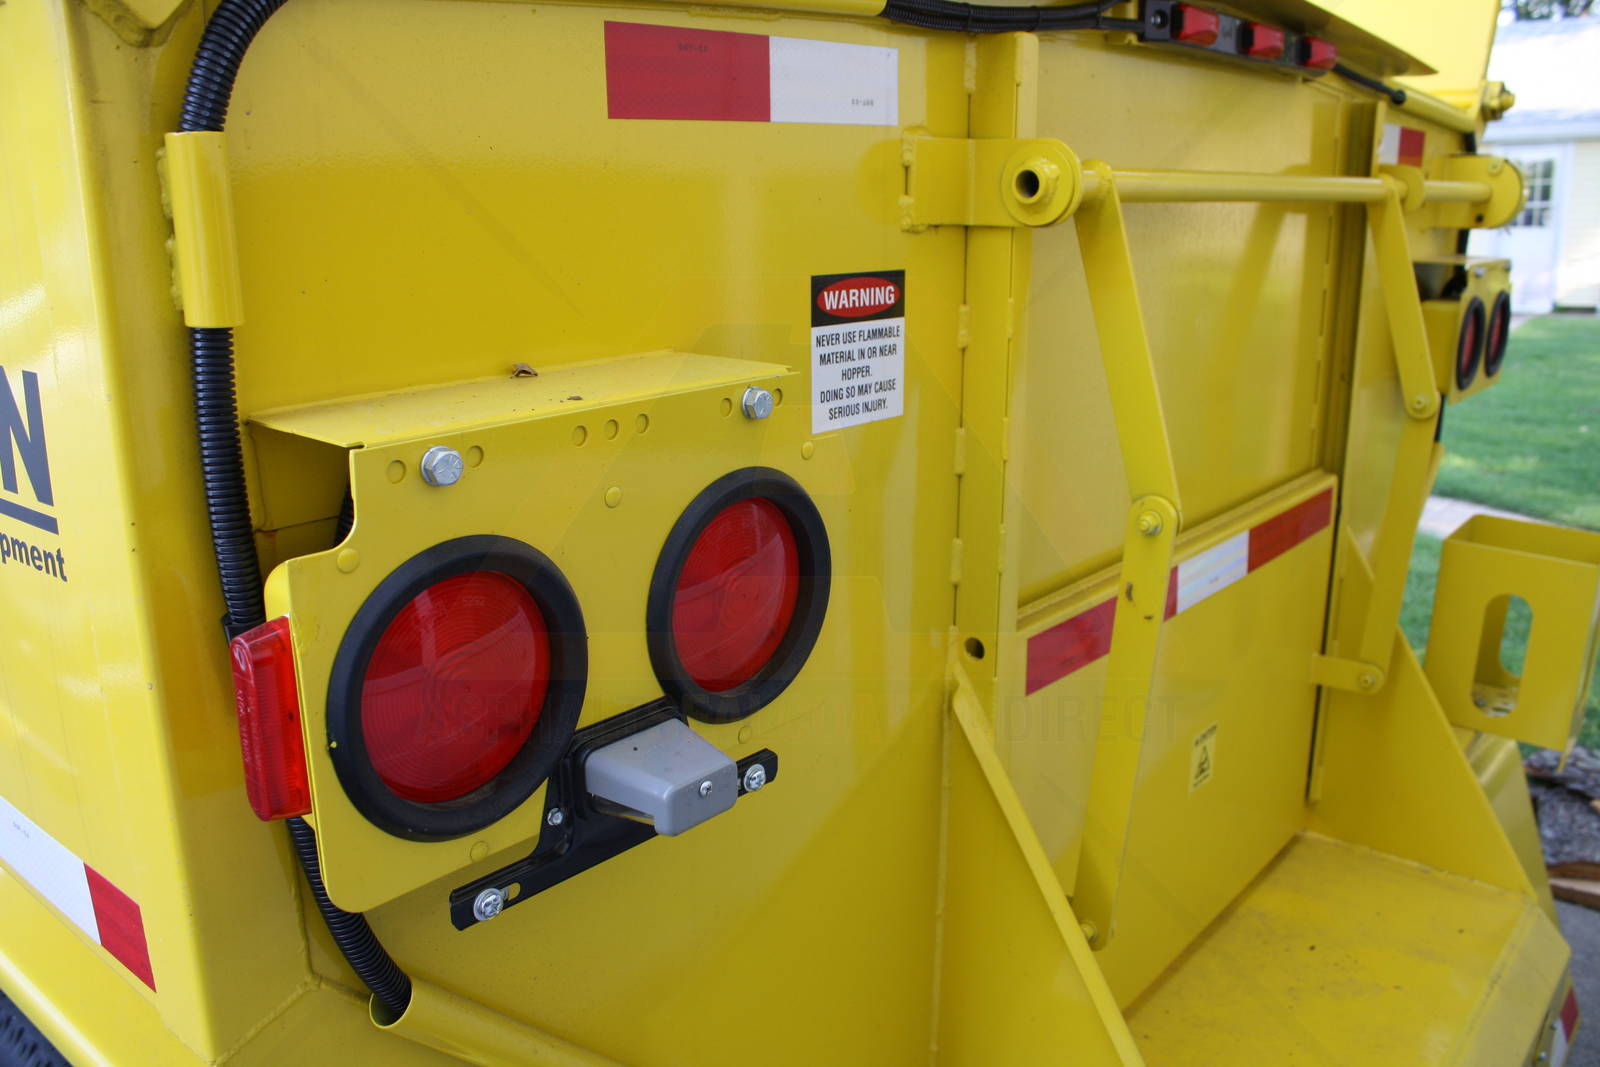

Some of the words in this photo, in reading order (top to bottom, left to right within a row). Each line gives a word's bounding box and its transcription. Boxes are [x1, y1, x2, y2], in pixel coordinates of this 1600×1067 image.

[824, 286, 895, 310] WARNING
[816, 333, 840, 347] NEVER
[842, 330, 857, 344] USE
[858, 325, 900, 342] FLAMMABLE
[819, 350, 856, 366] MATERIAL
[858, 348, 866, 360] IN
[867, 346, 878, 359] OR
[879, 344, 897, 357] NEAR
[841, 366, 872, 381] HOPPER.
[820, 389, 844, 404] DOING
[845, 386, 856, 399] SO
[857, 383, 872, 396] MAY
[874, 379, 896, 393] CAUSE
[828, 403, 860, 421] SERIOUS
[862, 398, 888, 412] INJURY.
